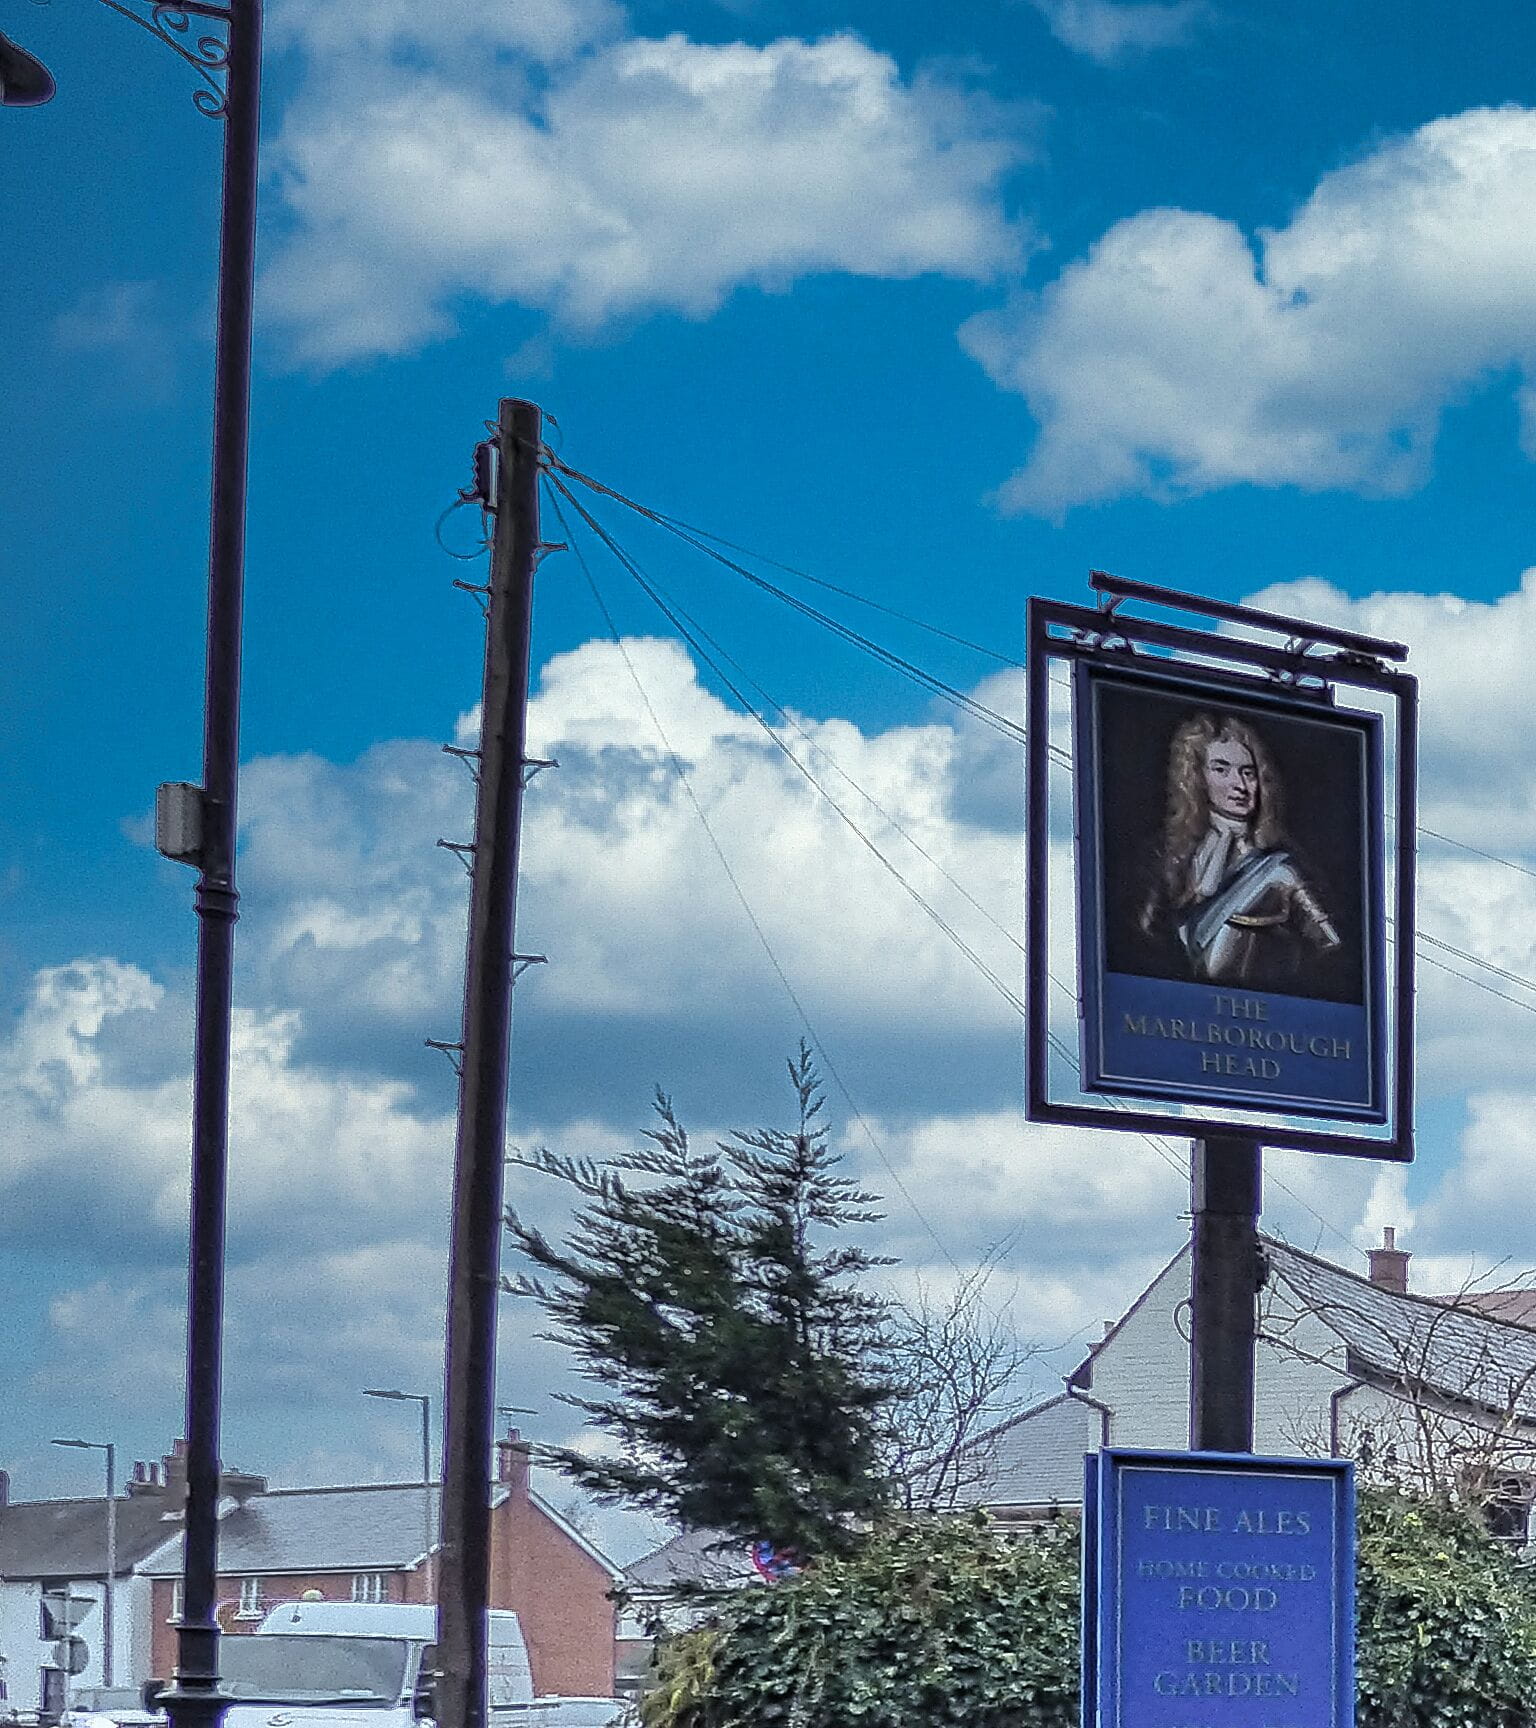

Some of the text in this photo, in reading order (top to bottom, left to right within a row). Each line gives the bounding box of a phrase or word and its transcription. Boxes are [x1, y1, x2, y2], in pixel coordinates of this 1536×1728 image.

[1212, 995, 1268, 1021] THE
[1123, 1012, 1352, 1060] MARLBOROUGH
[1200, 1051, 1281, 1081] HEAD
[1143, 1505, 1311, 1535] FINE ALES
[1136, 1559, 1317, 1582] HOME COOKED
[1178, 1586, 1278, 1612] FOOD
[1186, 1640, 1270, 1665] BEER
[1154, 1671, 1300, 1697] GARDEN
